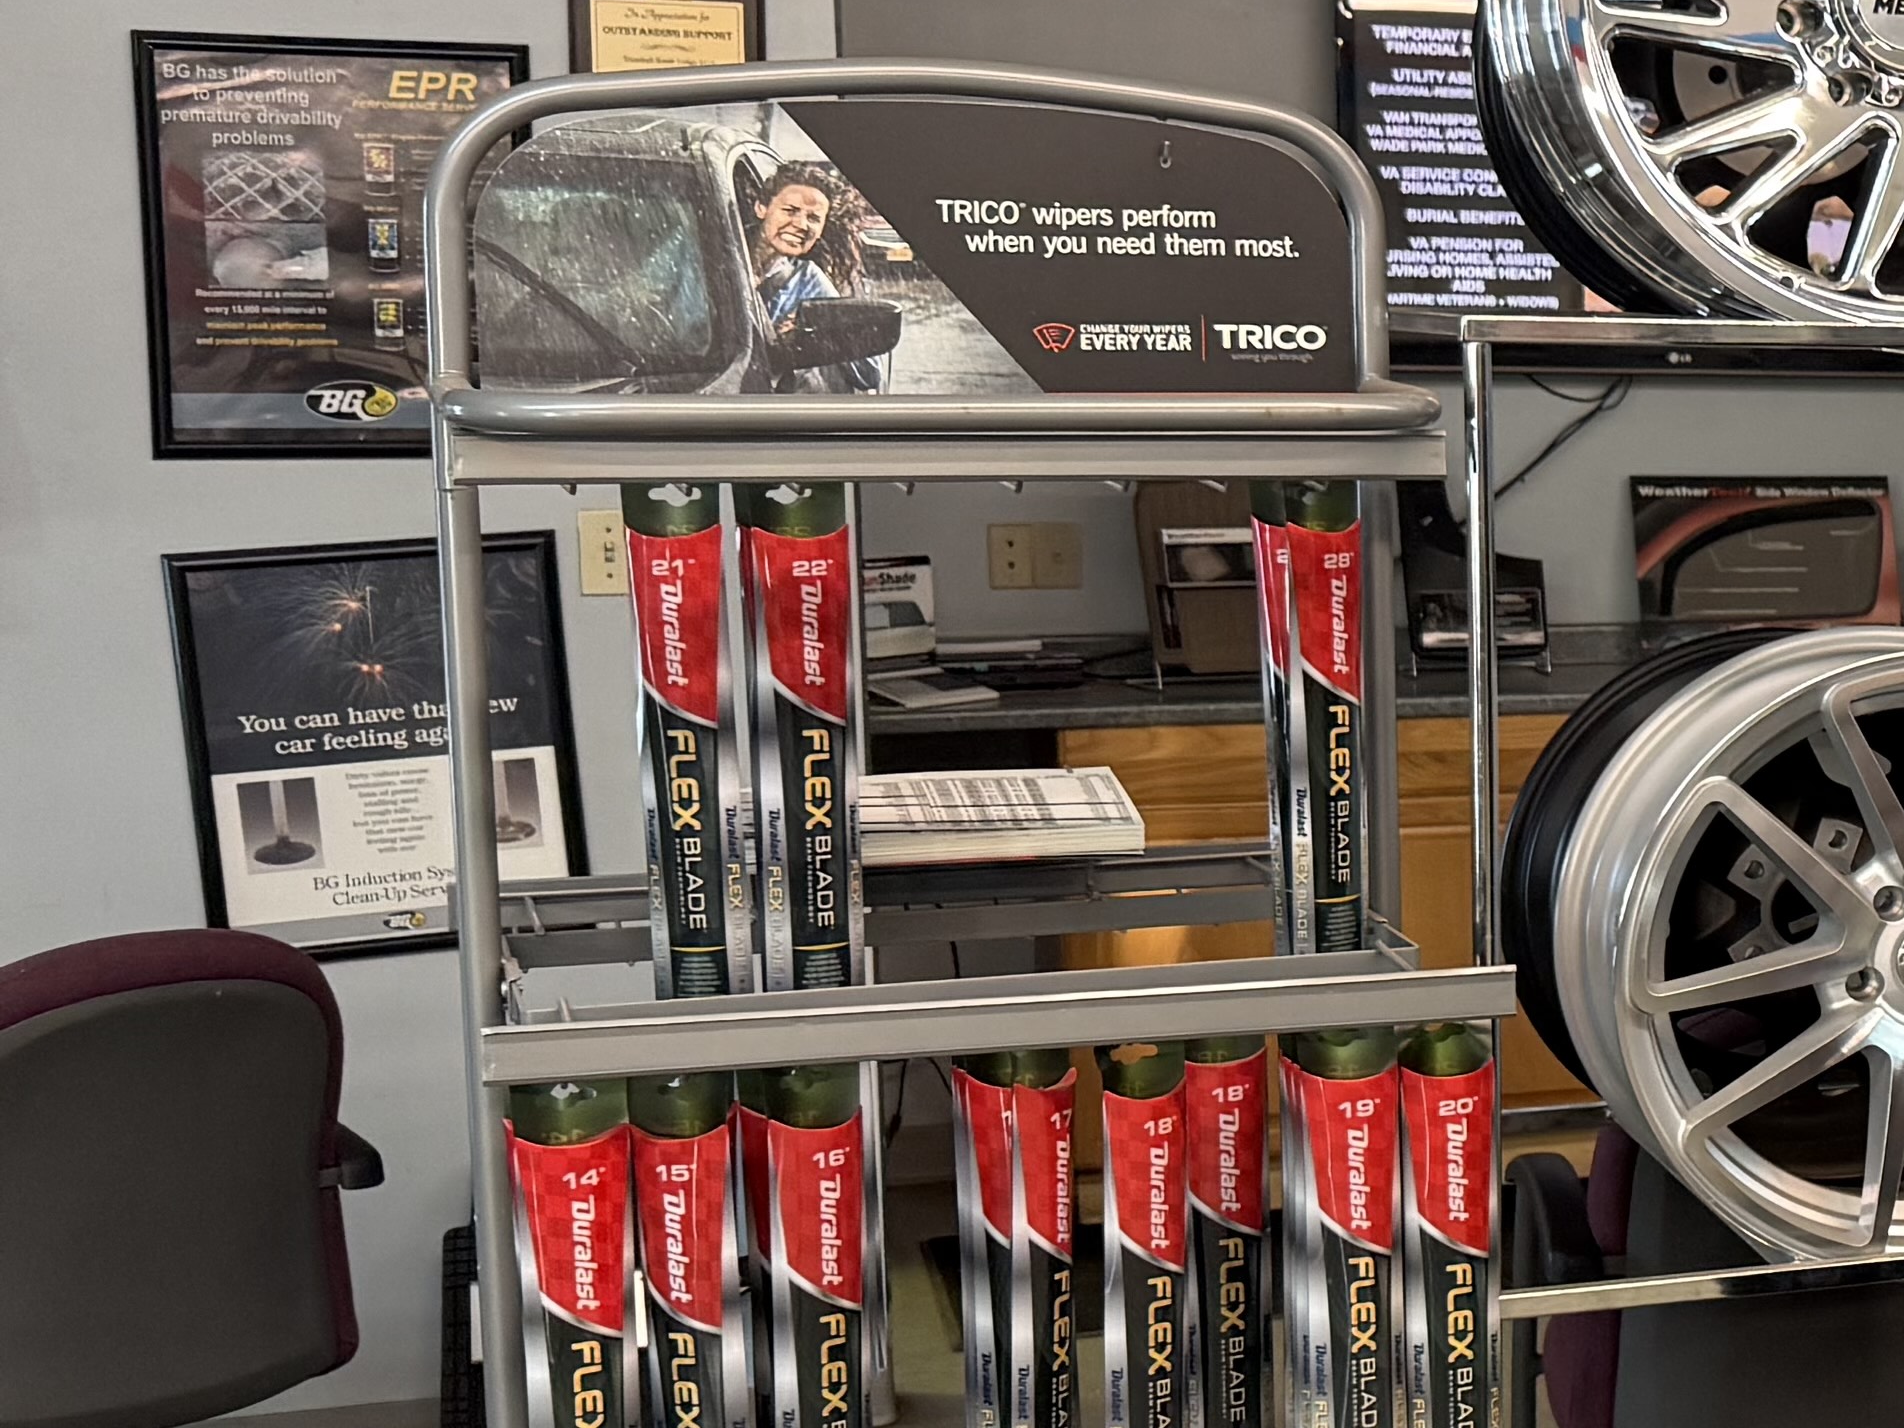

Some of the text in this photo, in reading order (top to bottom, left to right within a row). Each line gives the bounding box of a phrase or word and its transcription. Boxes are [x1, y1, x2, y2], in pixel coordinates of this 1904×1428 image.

[1372, 25, 1460, 42] TEMPORARY
[1386, 41, 1460, 57] FINANCIAL
[162, 63, 338, 85] BG has the solution
[193, 87, 310, 108] to preventing
[388, 70, 479, 102] EPR
[1391, 68, 1446, 84] UTILITY
[160, 105, 343, 130] premature drivability
[212, 131, 295, 148] problems
[1370, 139, 1446, 153] WADE PARK
[1385, 125, 1442, 140] MEDICAL
[1445, 127, 1482, 141] APPO
[1379, 166, 1460, 182] VA SERVICE
[1401, 181, 1507, 198] DISABILITY CLA
[936, 199, 1217, 232] TRICO wipers perform
[965, 231, 1300, 259] when you need them most.
[1405, 208, 1458, 224] BURIAL
[1409, 236, 1524, 253] VA PENSION FOR
[1455, 265, 1497, 280] HOME
[1499, 266, 1553, 281] HEALTH
[1080, 334, 1192, 352] EVERY YEAR
[1213, 324, 1328, 351] TRICO
[659, 579, 689, 687] Duralast
[800, 579, 826, 686] Duralast
[1330, 574, 1350, 674] Duralast
[237, 697, 518, 734] You can have tha ew
[275, 726, 450, 755] car feeling aga
[666, 729, 702, 831] FLEX
[802, 728, 833, 830] FLEX
[1328, 704, 1350, 797] FLEX
[1336, 800, 1350, 884] BLADE
[313, 866, 456, 891] BG Induction Sys
[332, 884, 448, 906] Clean-Up Serv
[683, 836, 707, 931] BLADE
[815, 834, 835, 929] BLADE
[1055, 1133, 1072, 1244] Duralast
[1218, 1107, 1242, 1213] Duralast
[1347, 1123, 1373, 1232] Duralast
[1446, 1117, 1470, 1222] Duralast
[1149, 1140, 1171, 1250] Duralast
[571, 1194, 603, 1311] Duralast
[663, 1188, 694, 1304] Duralast
[819, 1173, 845, 1287] Duralast
[1052, 1269, 1071, 1372] FLEX
[1147, 1275, 1173, 1377] FLEX
[1218, 1237, 1246, 1424] FLEX BLADE
[1348, 1256, 1378, 1355] FLEX
[1446, 1262, 1475, 1364] FLEX
[819, 1313, 849, 1418] FLEX
